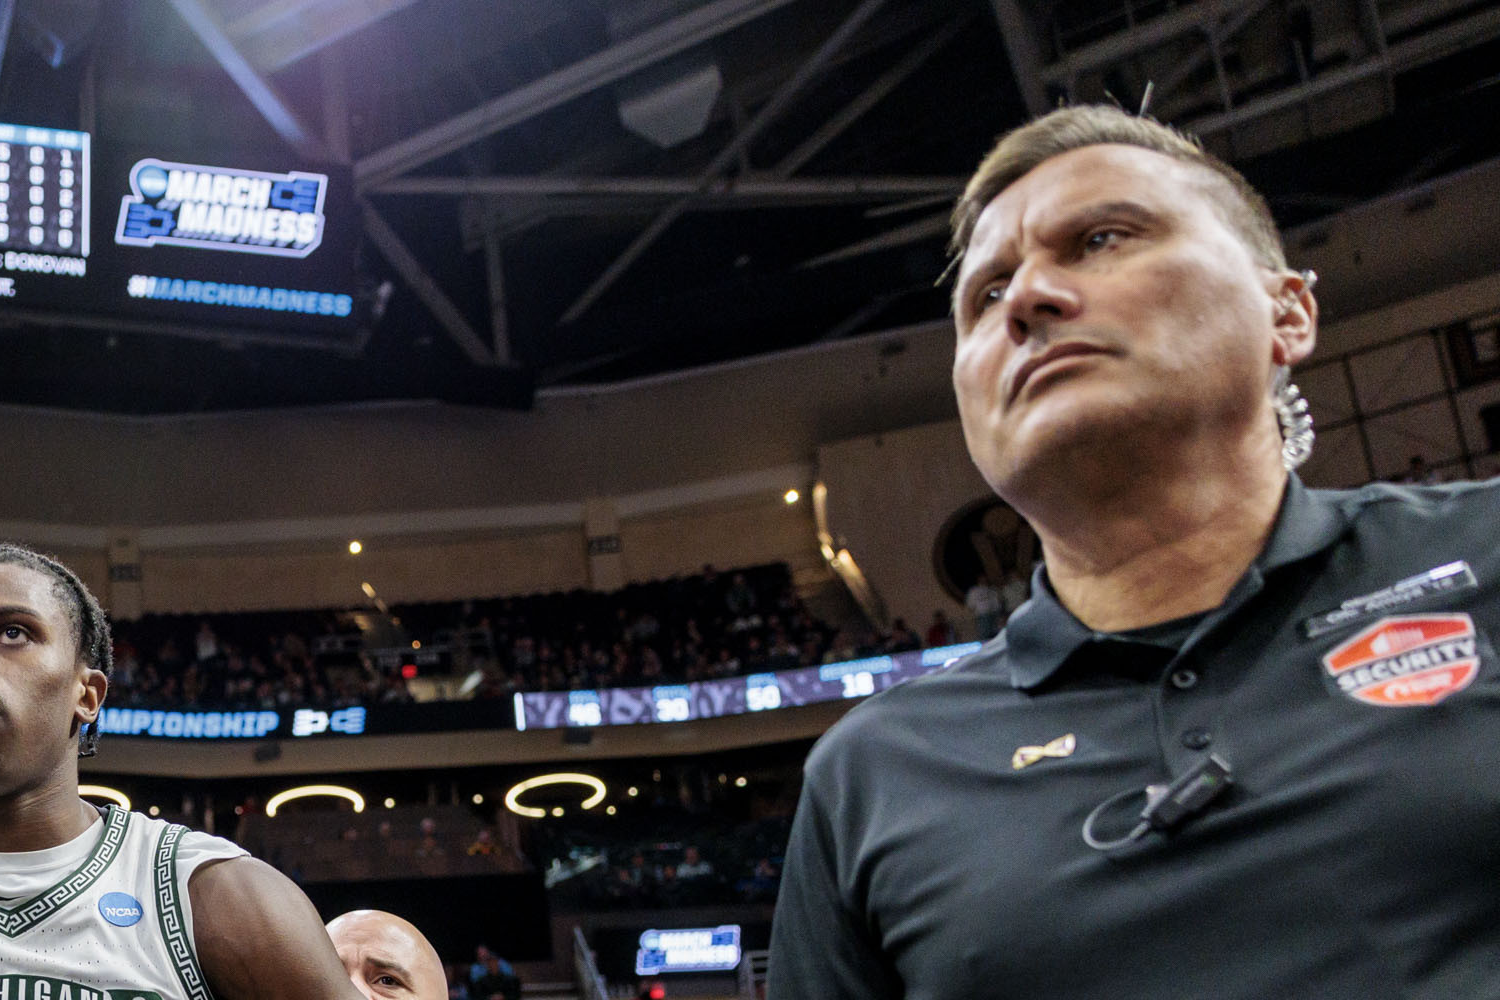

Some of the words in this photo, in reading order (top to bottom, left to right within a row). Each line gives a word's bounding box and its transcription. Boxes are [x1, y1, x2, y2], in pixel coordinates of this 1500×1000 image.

[164, 168, 273, 210] MARCH
[176, 201, 319, 246] MADNESS
[1337, 638, 1477, 692] SECURITY
[104, 906, 141, 918] NCAA
